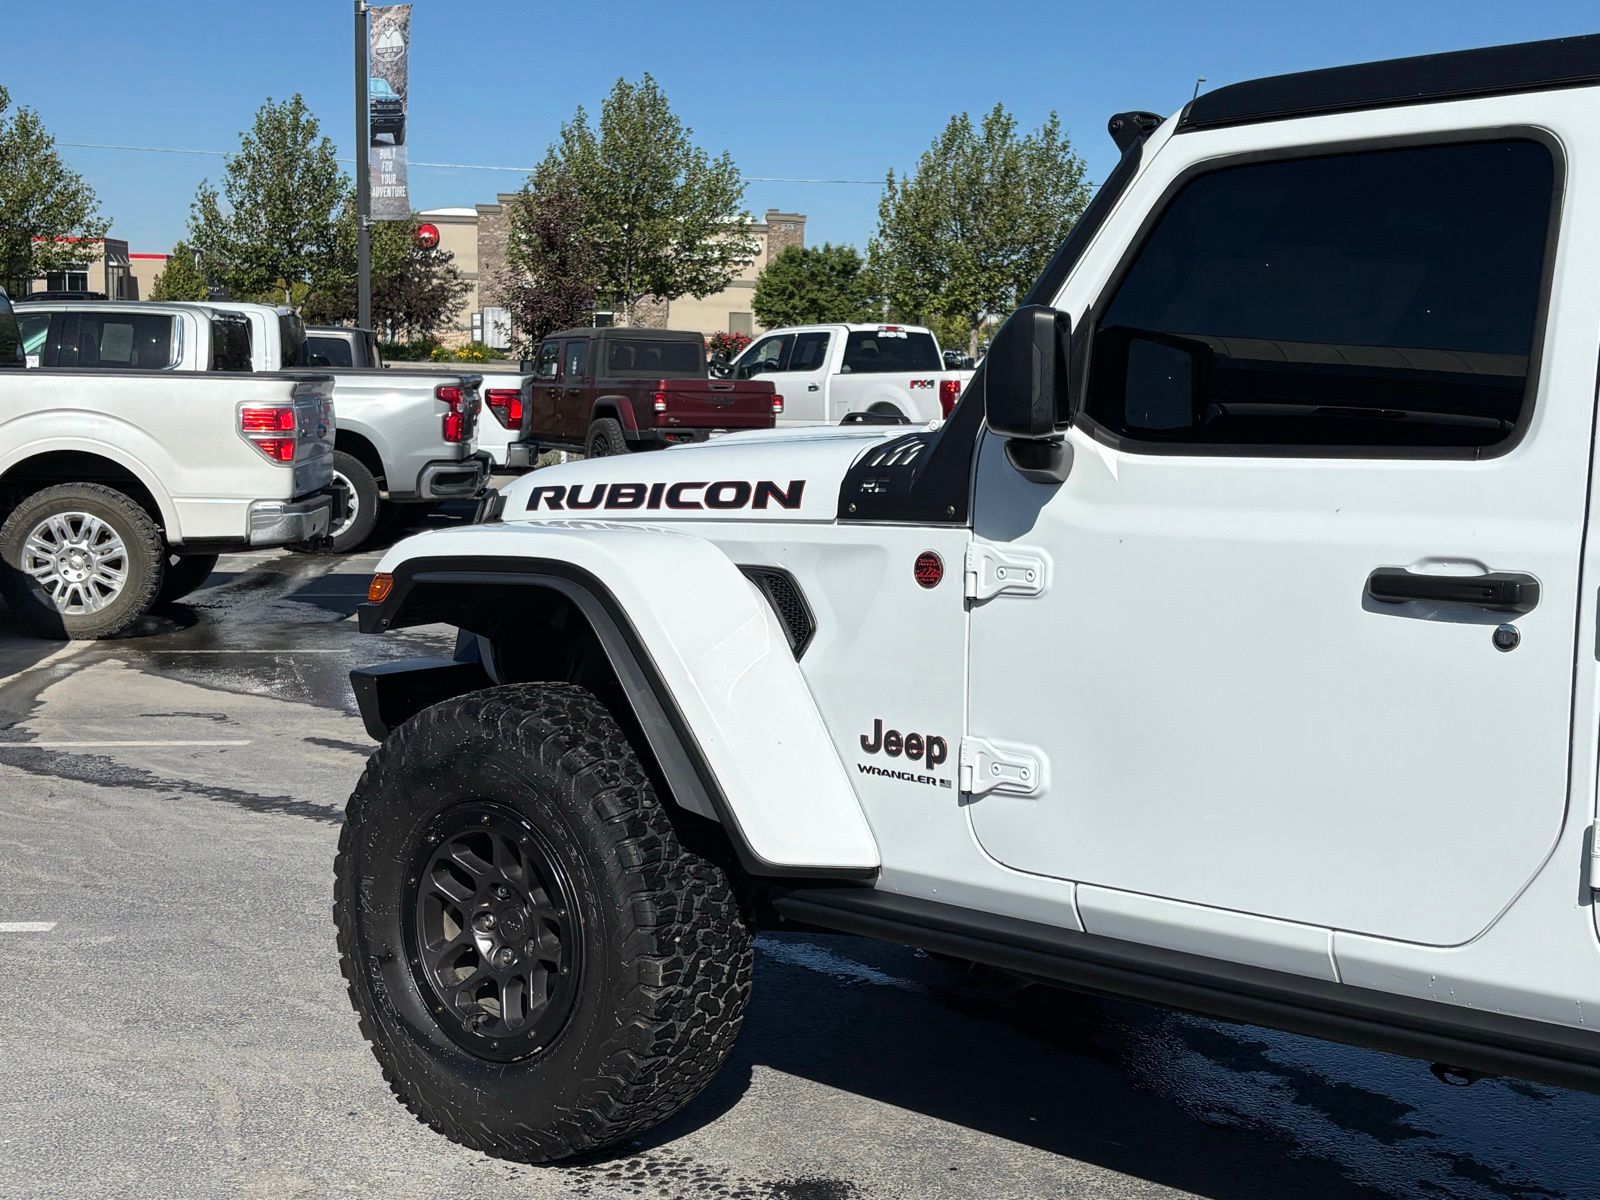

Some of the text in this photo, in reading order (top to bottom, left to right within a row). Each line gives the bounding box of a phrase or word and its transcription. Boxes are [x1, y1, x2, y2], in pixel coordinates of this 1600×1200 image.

[380, 148, 396, 159] BUILT
[381, 161, 393, 172] FOR
[381, 173, 396, 184] YOUR
[371, 186, 406, 197] ADVENTURE
[525, 480, 806, 511] RUBICON
[860, 718, 948, 771] Jeep
[857, 763, 937, 787] WRANGLER
